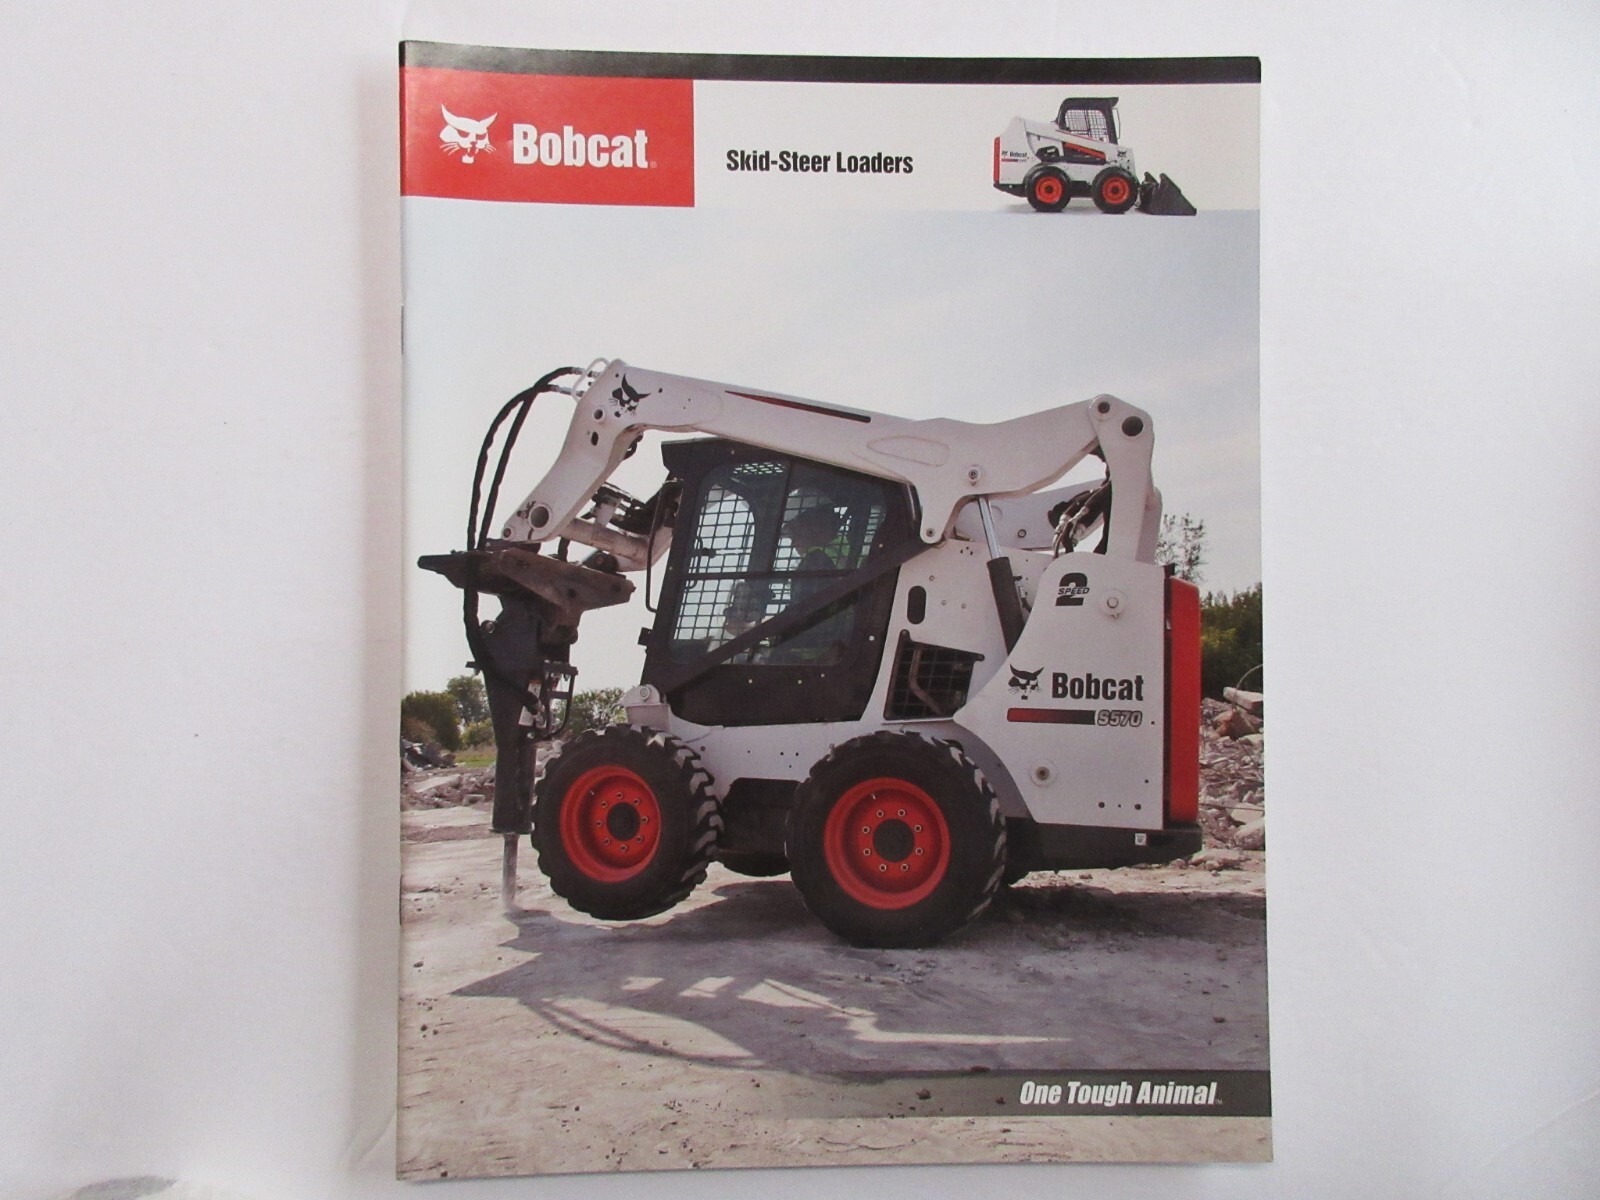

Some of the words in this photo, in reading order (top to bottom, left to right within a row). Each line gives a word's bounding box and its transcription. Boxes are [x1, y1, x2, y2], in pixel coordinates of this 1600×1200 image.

[512, 123, 649, 169] Bobcat
[726, 149, 831, 173] Skid-Steer
[836, 151, 914, 174] Loaders
[1055, 572, 1088, 607] 2
[1057, 587, 1090, 595] SPEED
[1052, 672, 1144, 701] Bobcat
[1097, 709, 1143, 727] S570
[1019, 1081, 1062, 1105] One
[1067, 1081, 1133, 1107] Tough
[1136, 1081, 1218, 1105] Animal
